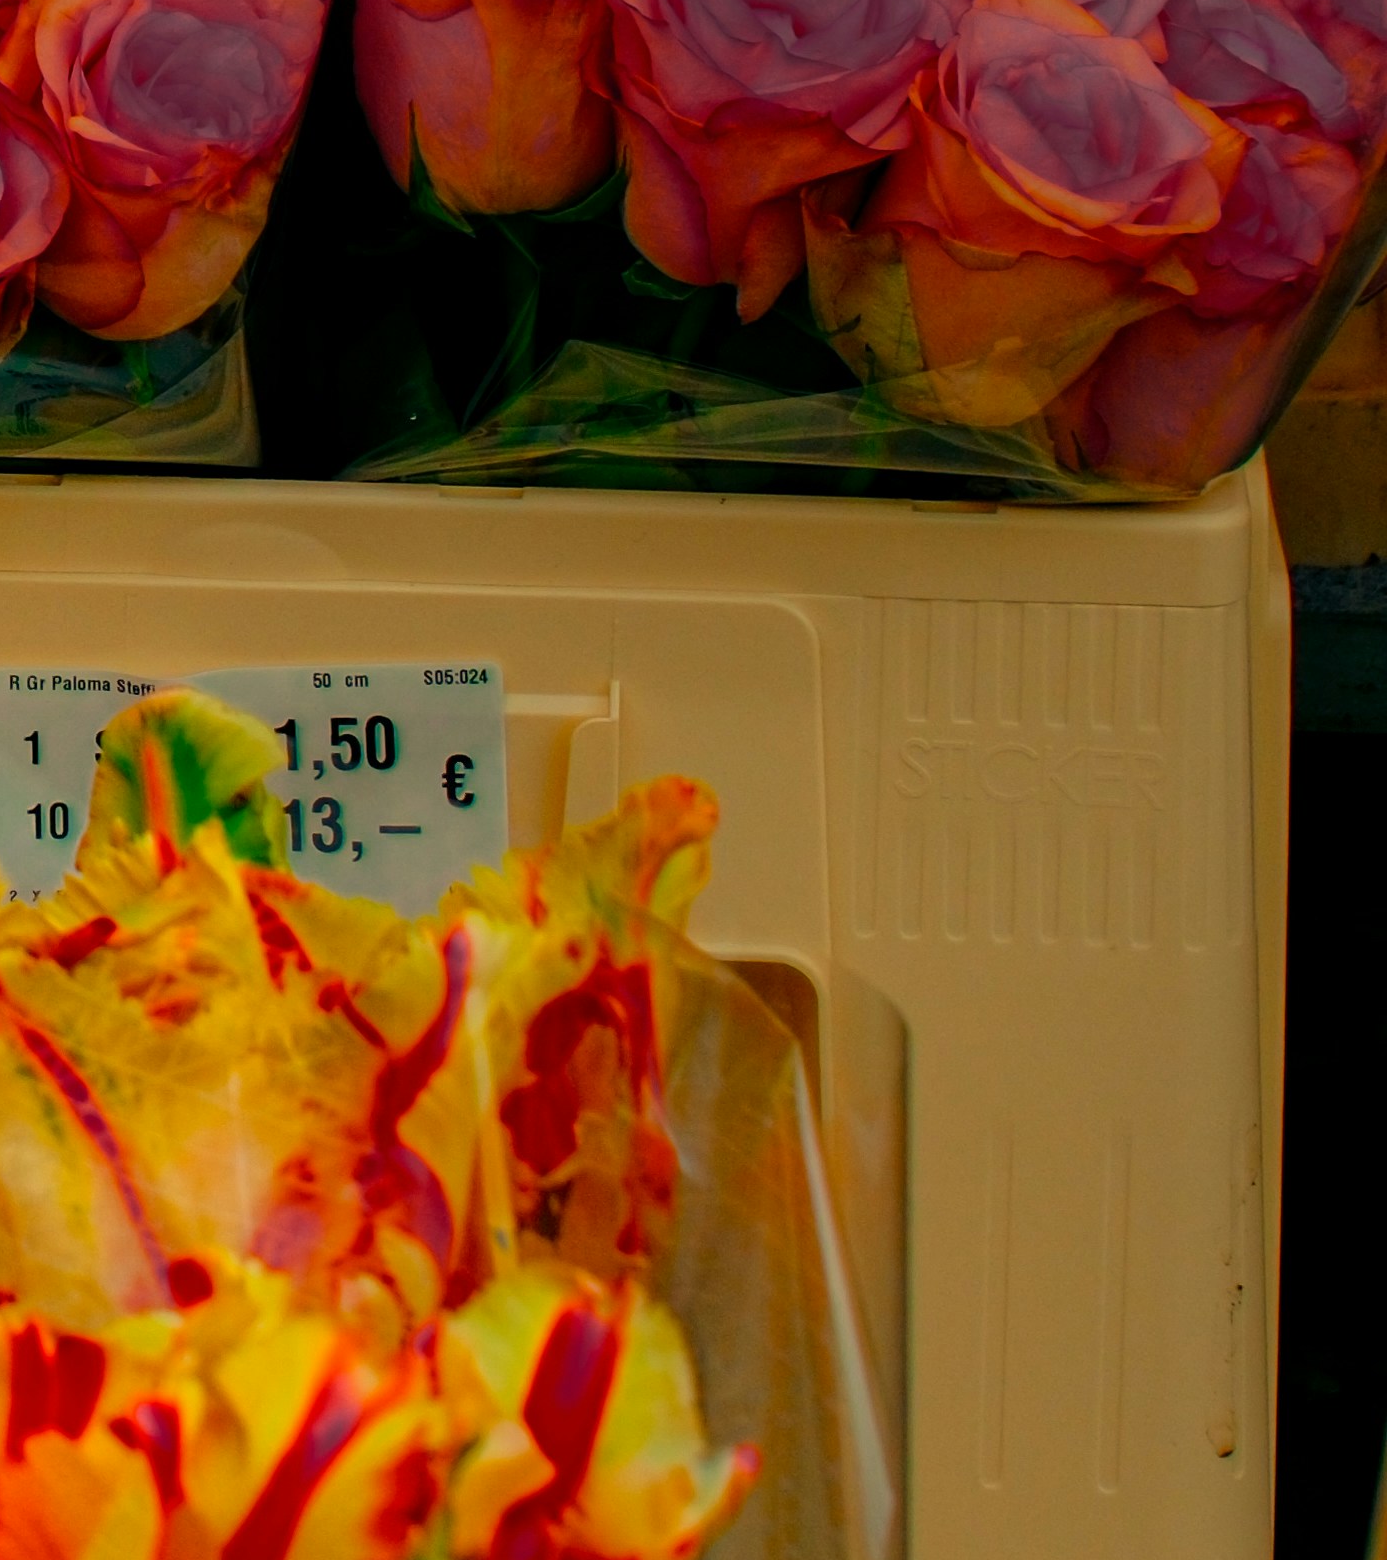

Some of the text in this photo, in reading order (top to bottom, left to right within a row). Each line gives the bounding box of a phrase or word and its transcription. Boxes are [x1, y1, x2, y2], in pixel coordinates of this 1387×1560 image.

[9, 675, 20, 691] R
[27, 675, 45, 691] Gr
[52, 675, 111, 692] Paloma
[312, 672, 332, 689] 50
[345, 673, 369, 689] cm
[423, 668, 489, 687] S05:024
[24, 730, 40, 766] 1
[274, 714, 396, 781] 1,50
[441, 753, 476, 809] €
[27, 801, 70, 841] 10
